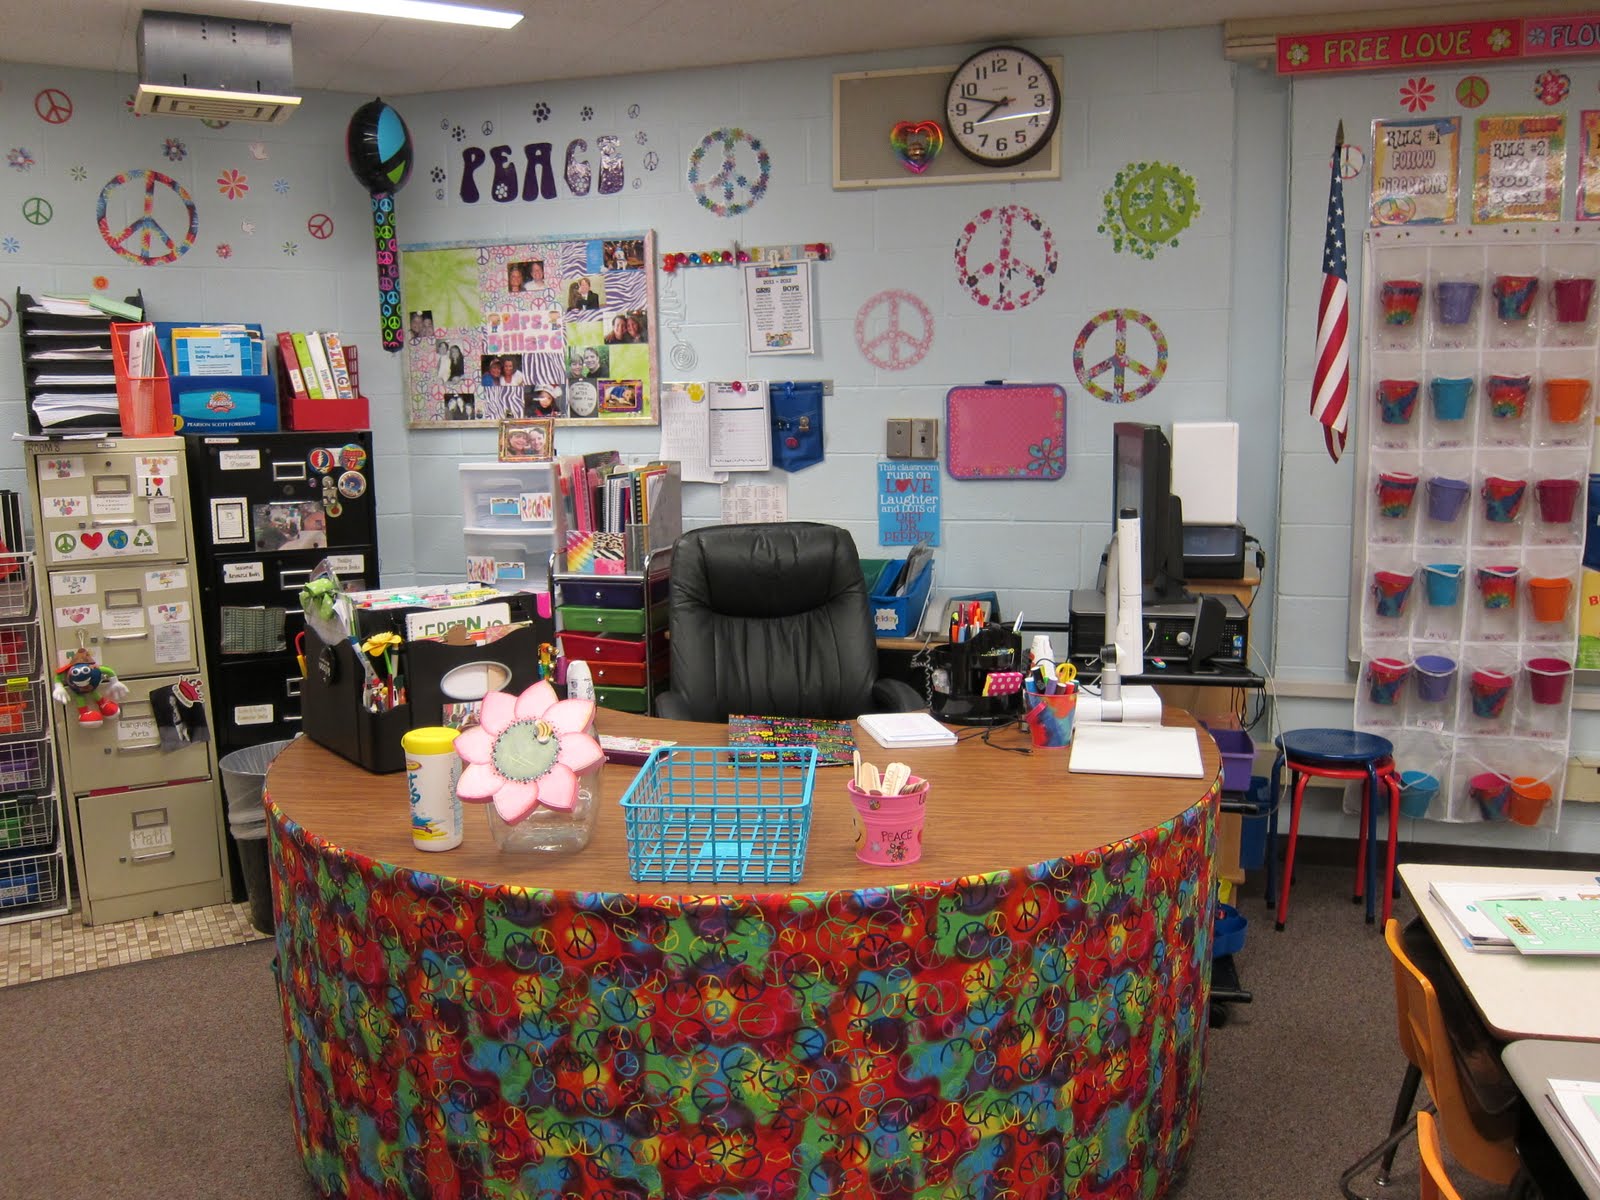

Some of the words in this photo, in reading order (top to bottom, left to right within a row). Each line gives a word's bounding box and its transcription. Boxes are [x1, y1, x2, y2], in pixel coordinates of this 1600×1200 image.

[1324, 36, 1391, 64] FREE
[1401, 30, 1472, 59] LOVE
[992, 59, 1007, 73] 12
[1017, 62, 1022, 75] 1
[976, 66, 987, 80] 11
[1027, 75, 1038, 89] 2
[961, 83, 977, 97] 10
[1034, 94, 1045, 107] 3
[956, 103, 967, 116] 9
[1028, 115, 1039, 127] 4
[963, 122, 974, 134] 8
[978, 134, 988, 147] 7
[1015, 130, 1026, 143] 5
[1386, 129, 1422, 149] RULE
[1427, 129, 1441, 144] #1
[996, 138, 1008, 151] 6
[1494, 142, 1525, 159] RULE
[1530, 141, 1546, 156] #2
[1392, 150, 1436, 170] FOLLOW
[460, 136, 625, 203] PEACE
[880, 463, 896, 471] This
[897, 463, 939, 471] classroom
[886, 471, 914, 479] runs
[916, 471, 931, 479] on
[880, 494, 938, 506] Laughter
[881, 505, 899, 513] and
[902, 505, 925, 513] LOTS
[926, 505, 936, 513] of
[133, 829, 168, 847] Math
[881, 829, 913, 842] PEACE
